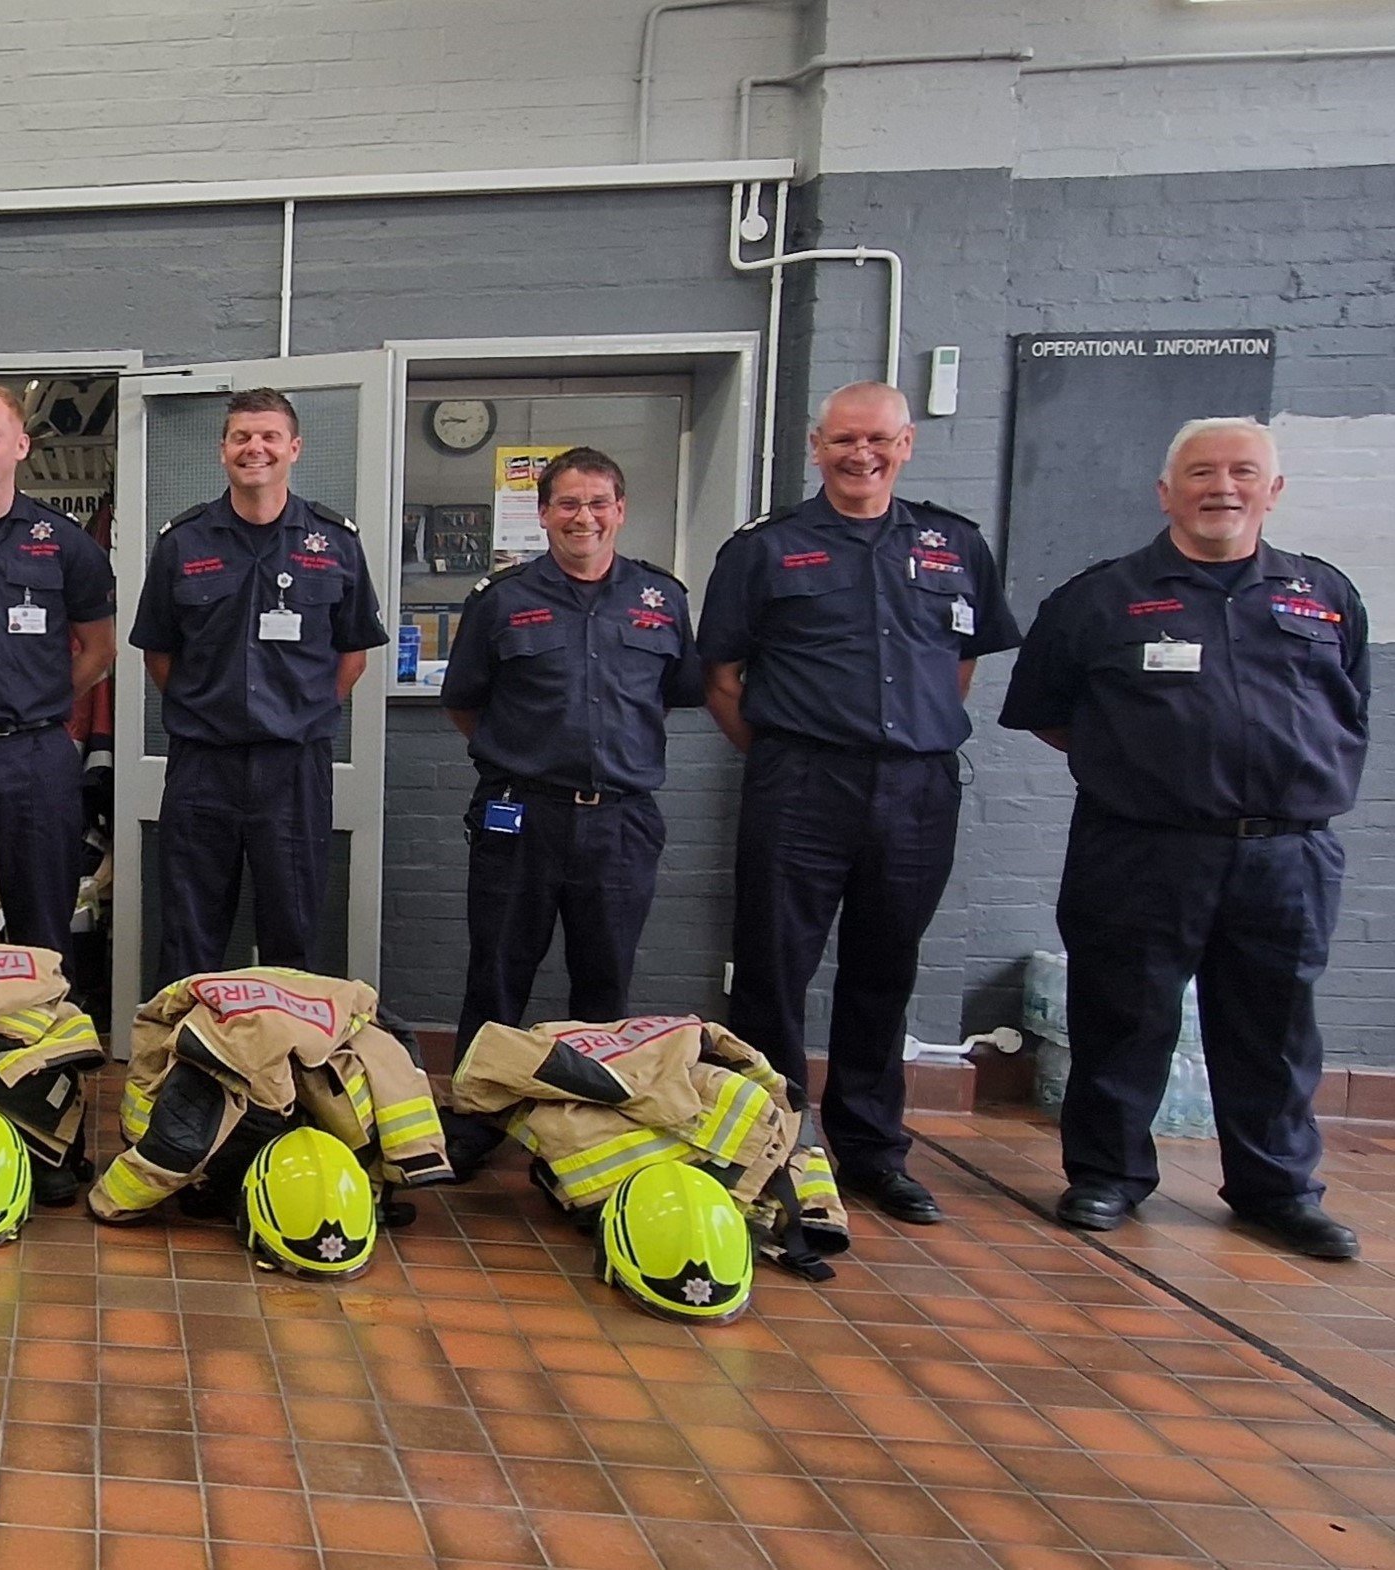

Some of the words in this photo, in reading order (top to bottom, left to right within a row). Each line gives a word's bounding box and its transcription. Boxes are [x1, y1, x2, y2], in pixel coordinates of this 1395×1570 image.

[1031, 340, 1147, 357] OPERATIONAL
[1154, 338, 1270, 356] INFORMATION
[50, 495, 102, 513] BOAR
[204, 983, 266, 1005] FIRE
[275, 989, 327, 1018] TAN
